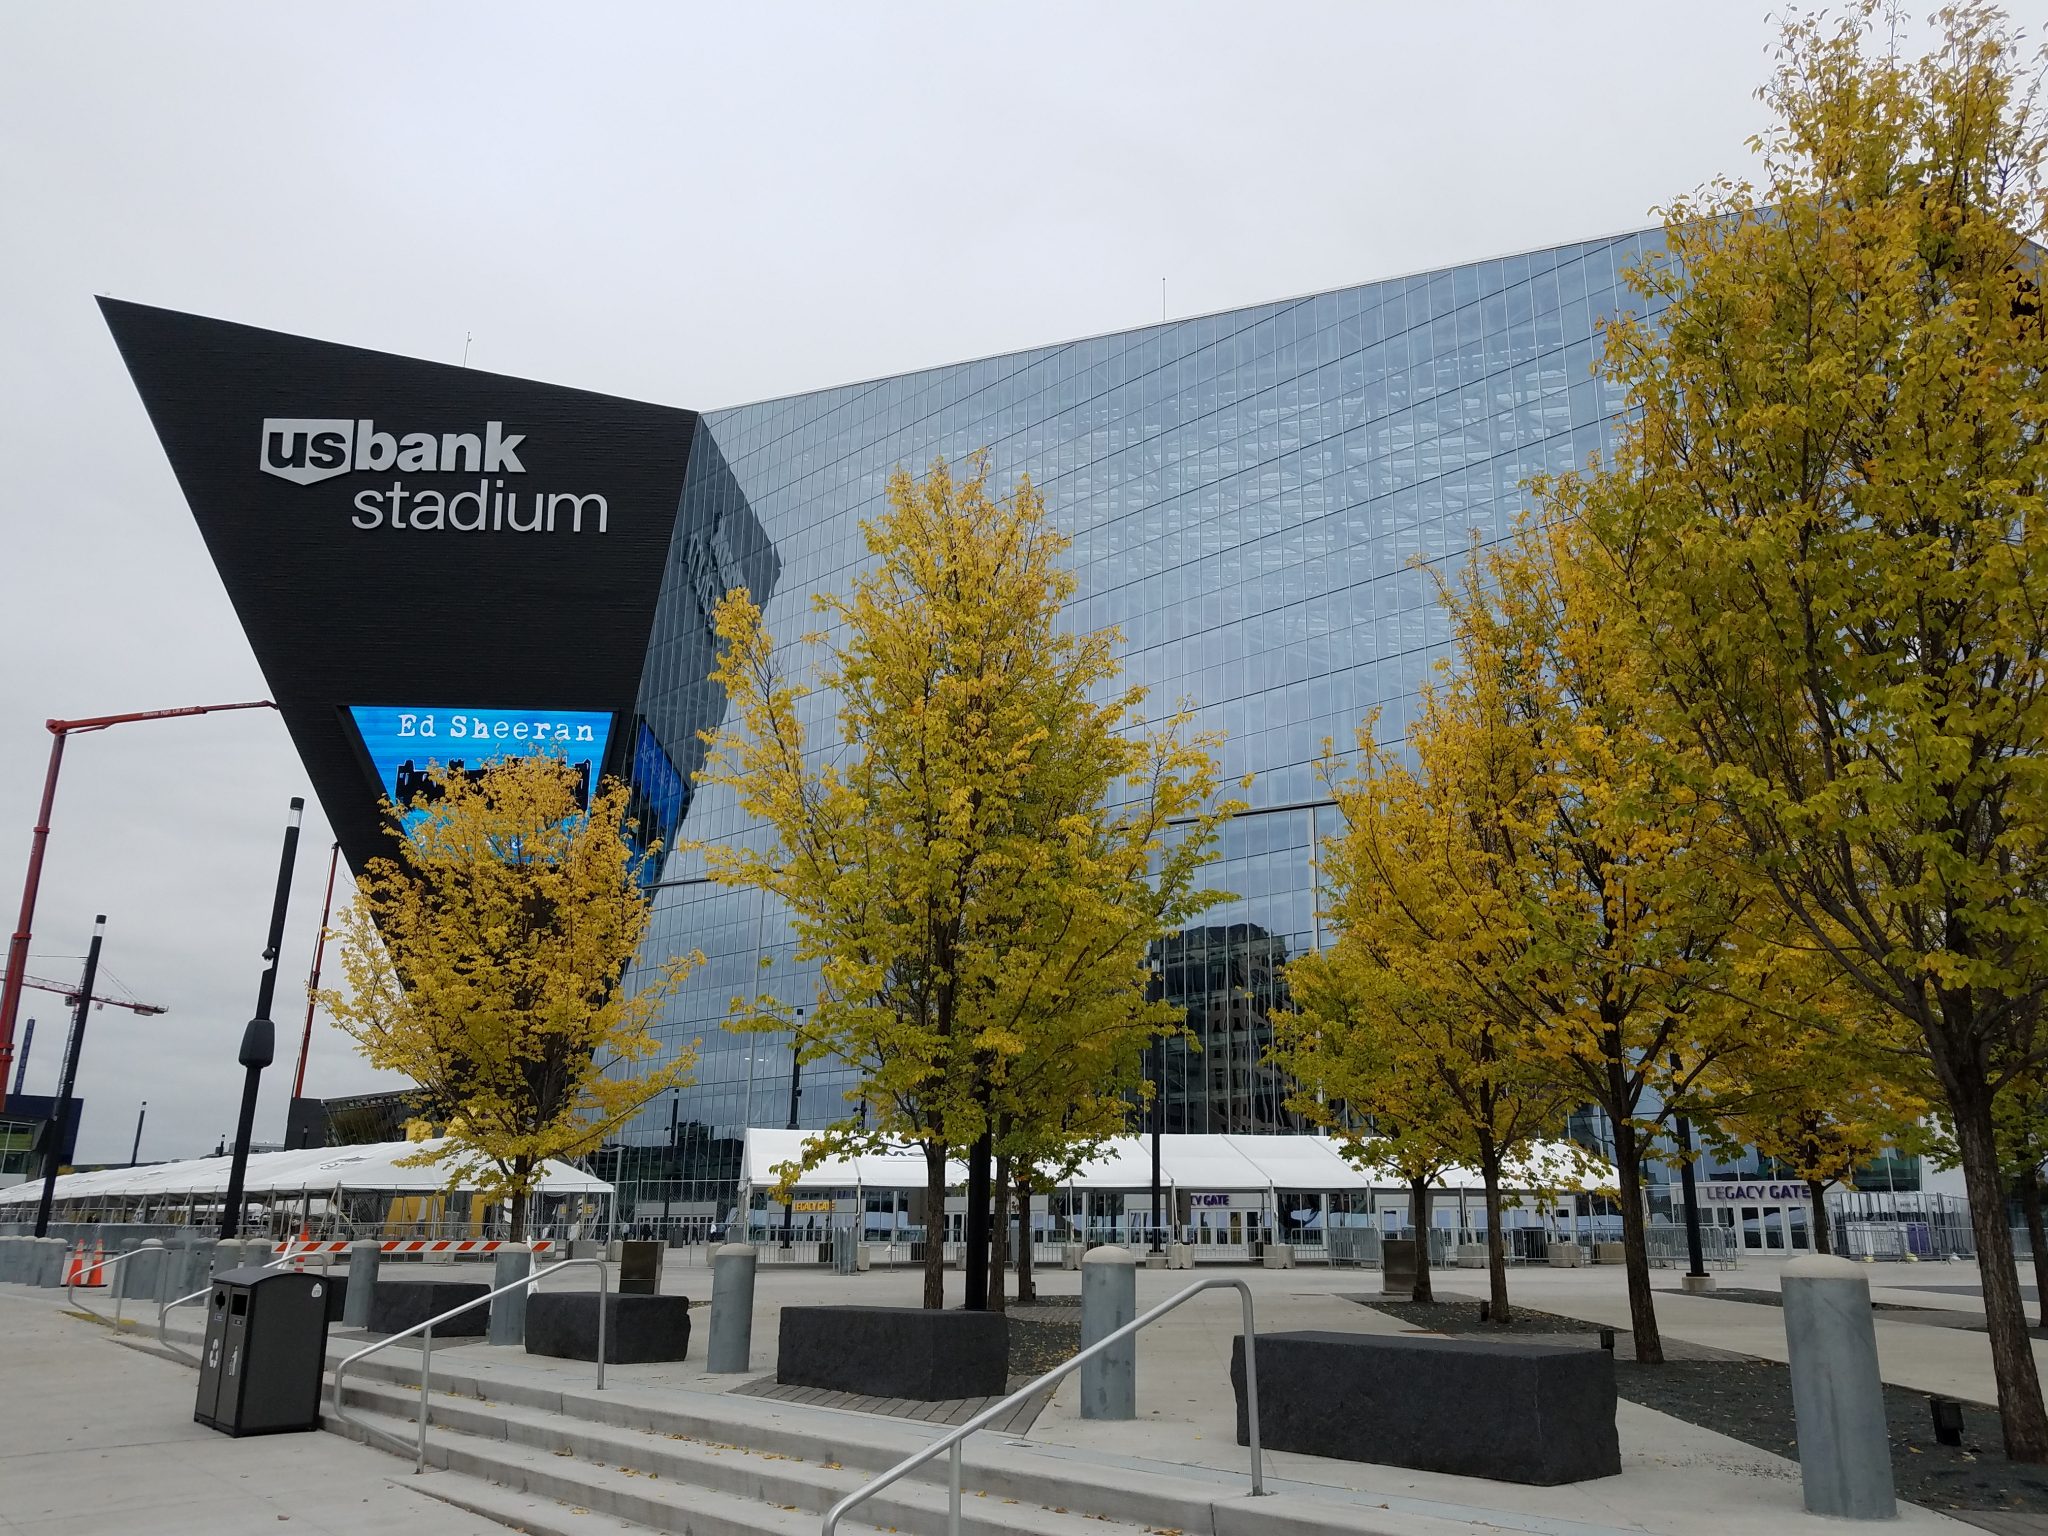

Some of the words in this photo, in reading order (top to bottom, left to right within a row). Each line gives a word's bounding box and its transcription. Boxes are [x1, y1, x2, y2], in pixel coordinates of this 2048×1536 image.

[351, 479, 609, 533] stadium
[397, 714, 437, 738] Ed
[450, 715, 595, 742] Sheeran
[1203, 1194, 1230, 1206] GATE
[1707, 1185, 1765, 1200] LEGACY
[1769, 1184, 1811, 1200] GATE
